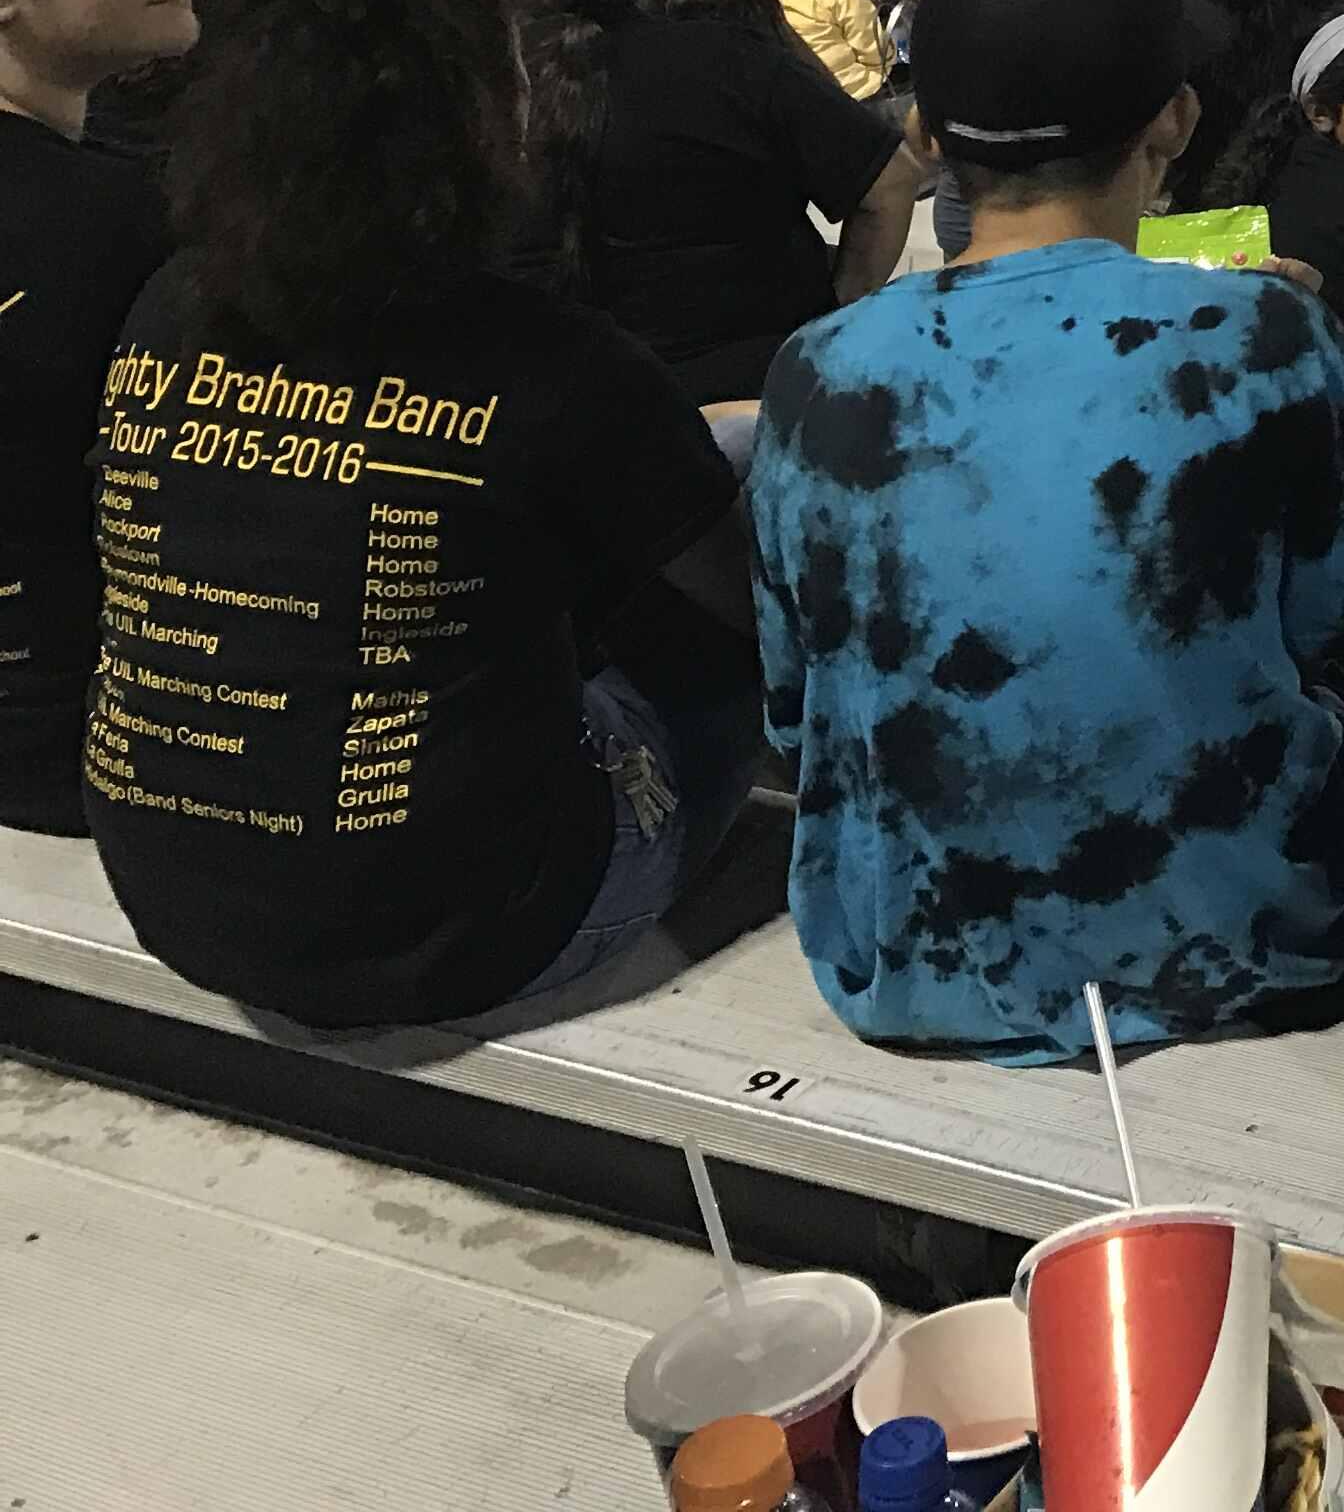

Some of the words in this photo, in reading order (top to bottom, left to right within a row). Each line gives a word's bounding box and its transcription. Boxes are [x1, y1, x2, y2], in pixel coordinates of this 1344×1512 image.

[104, 343, 179, 413] ighty
[187, 352, 355, 426] Brahma
[364, 376, 498, 447] Band
[109, 410, 167, 456] Tour
[170, 419, 366, 485] 2015-2016
[99, 489, 132, 511] Alice
[370, 502, 439, 525] Home
[368, 529, 439, 550] Home
[366, 554, 439, 575] Home
[364, 577, 485, 598] Robstown
[362, 602, 436, 621] Home
[115, 612, 137, 637] UIL
[141, 619, 219, 655] Marching
[361, 621, 469, 644] Ingleside
[359, 645, 411, 665] TBA
[112, 657, 134, 682] UIL
[137, 667, 212, 702] Marching
[216, 683, 288, 710] Contest
[351, 688, 430, 711] Mathis
[109, 703, 173, 744] Marching
[176, 726, 245, 754] Contest
[346, 709, 430, 734] Zapata
[342, 731, 419, 758] Sinton
[96, 749, 135, 780] Grulla
[340, 758, 412, 783] Home
[337, 782, 409, 808] Grulla
[181, 796, 245, 824] Seniors
[249, 810, 304, 836] Night)
[335, 808, 408, 833] Home
[743, 1070, 800, 1101] 16
